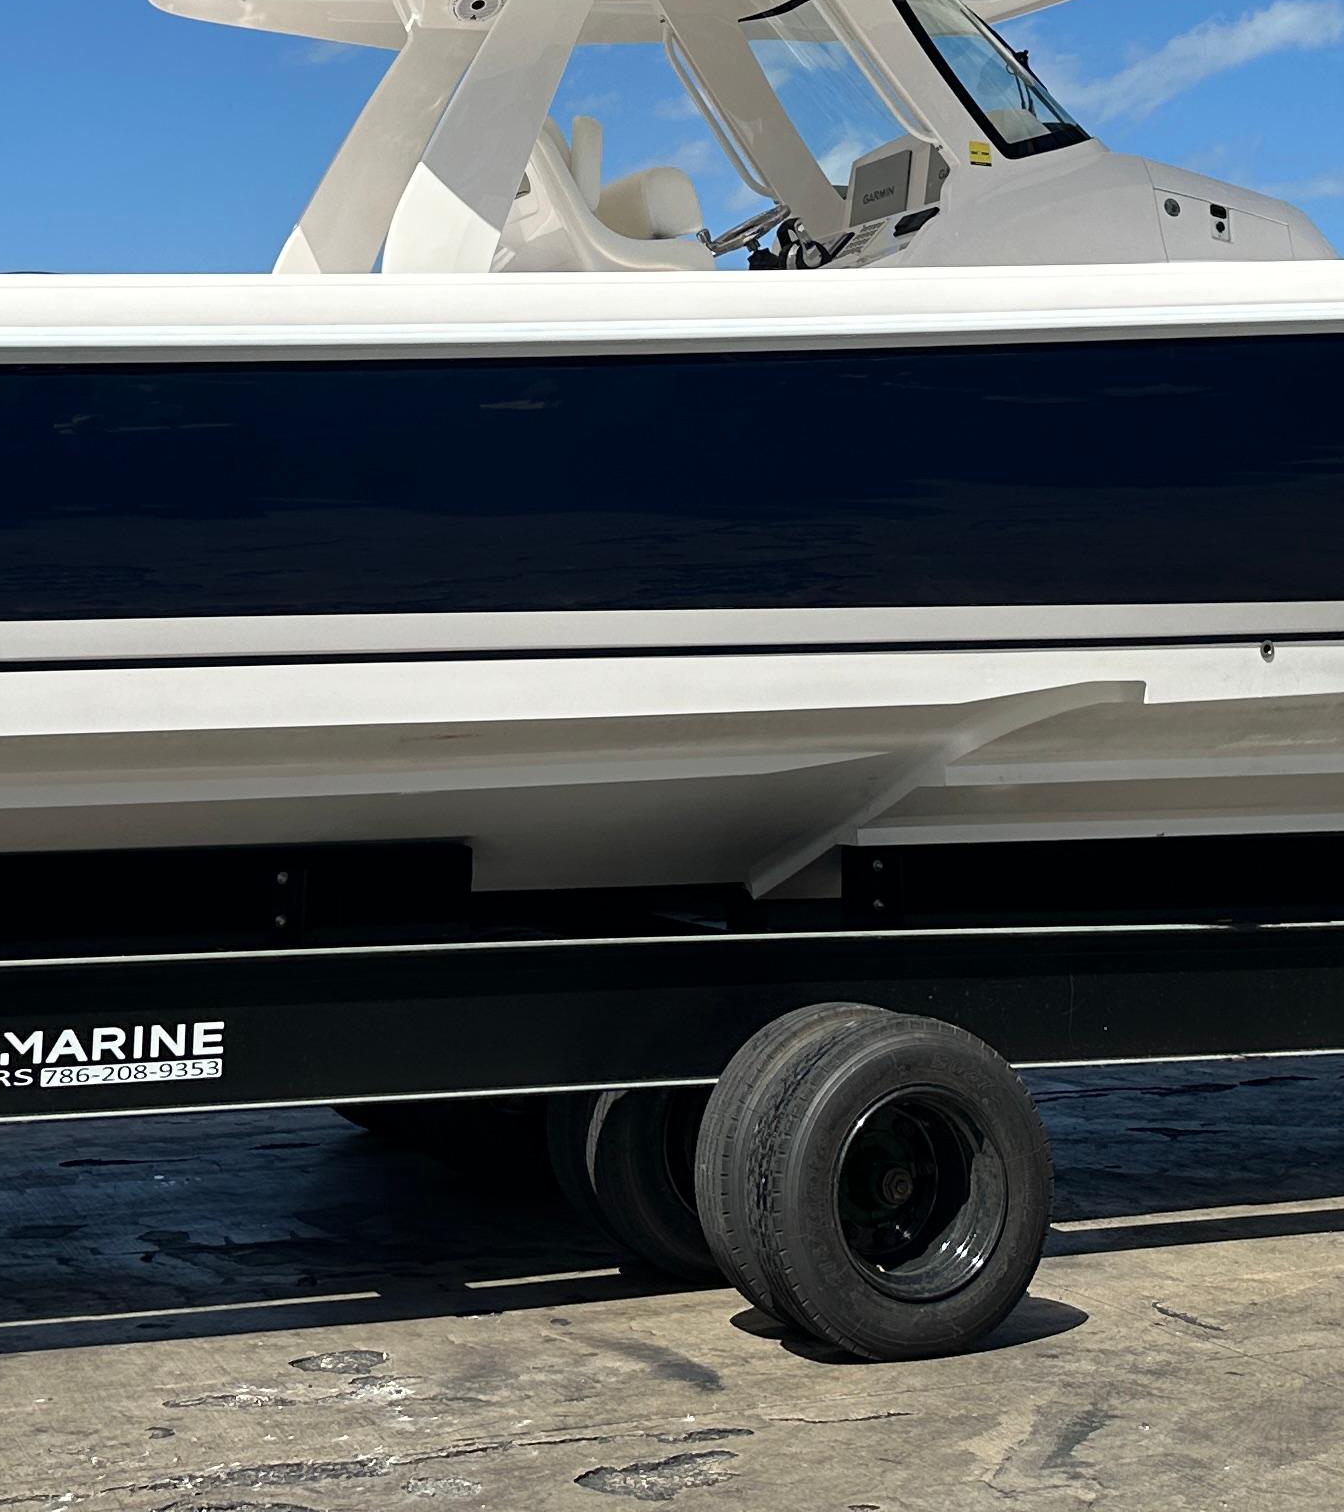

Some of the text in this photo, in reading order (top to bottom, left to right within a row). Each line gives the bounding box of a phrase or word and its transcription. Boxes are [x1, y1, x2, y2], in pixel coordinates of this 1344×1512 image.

[862, 185, 895, 205] GARMIN
[0, 1021, 225, 1067] MARINE
[43, 1060, 220, 1086] 786-208-9353
